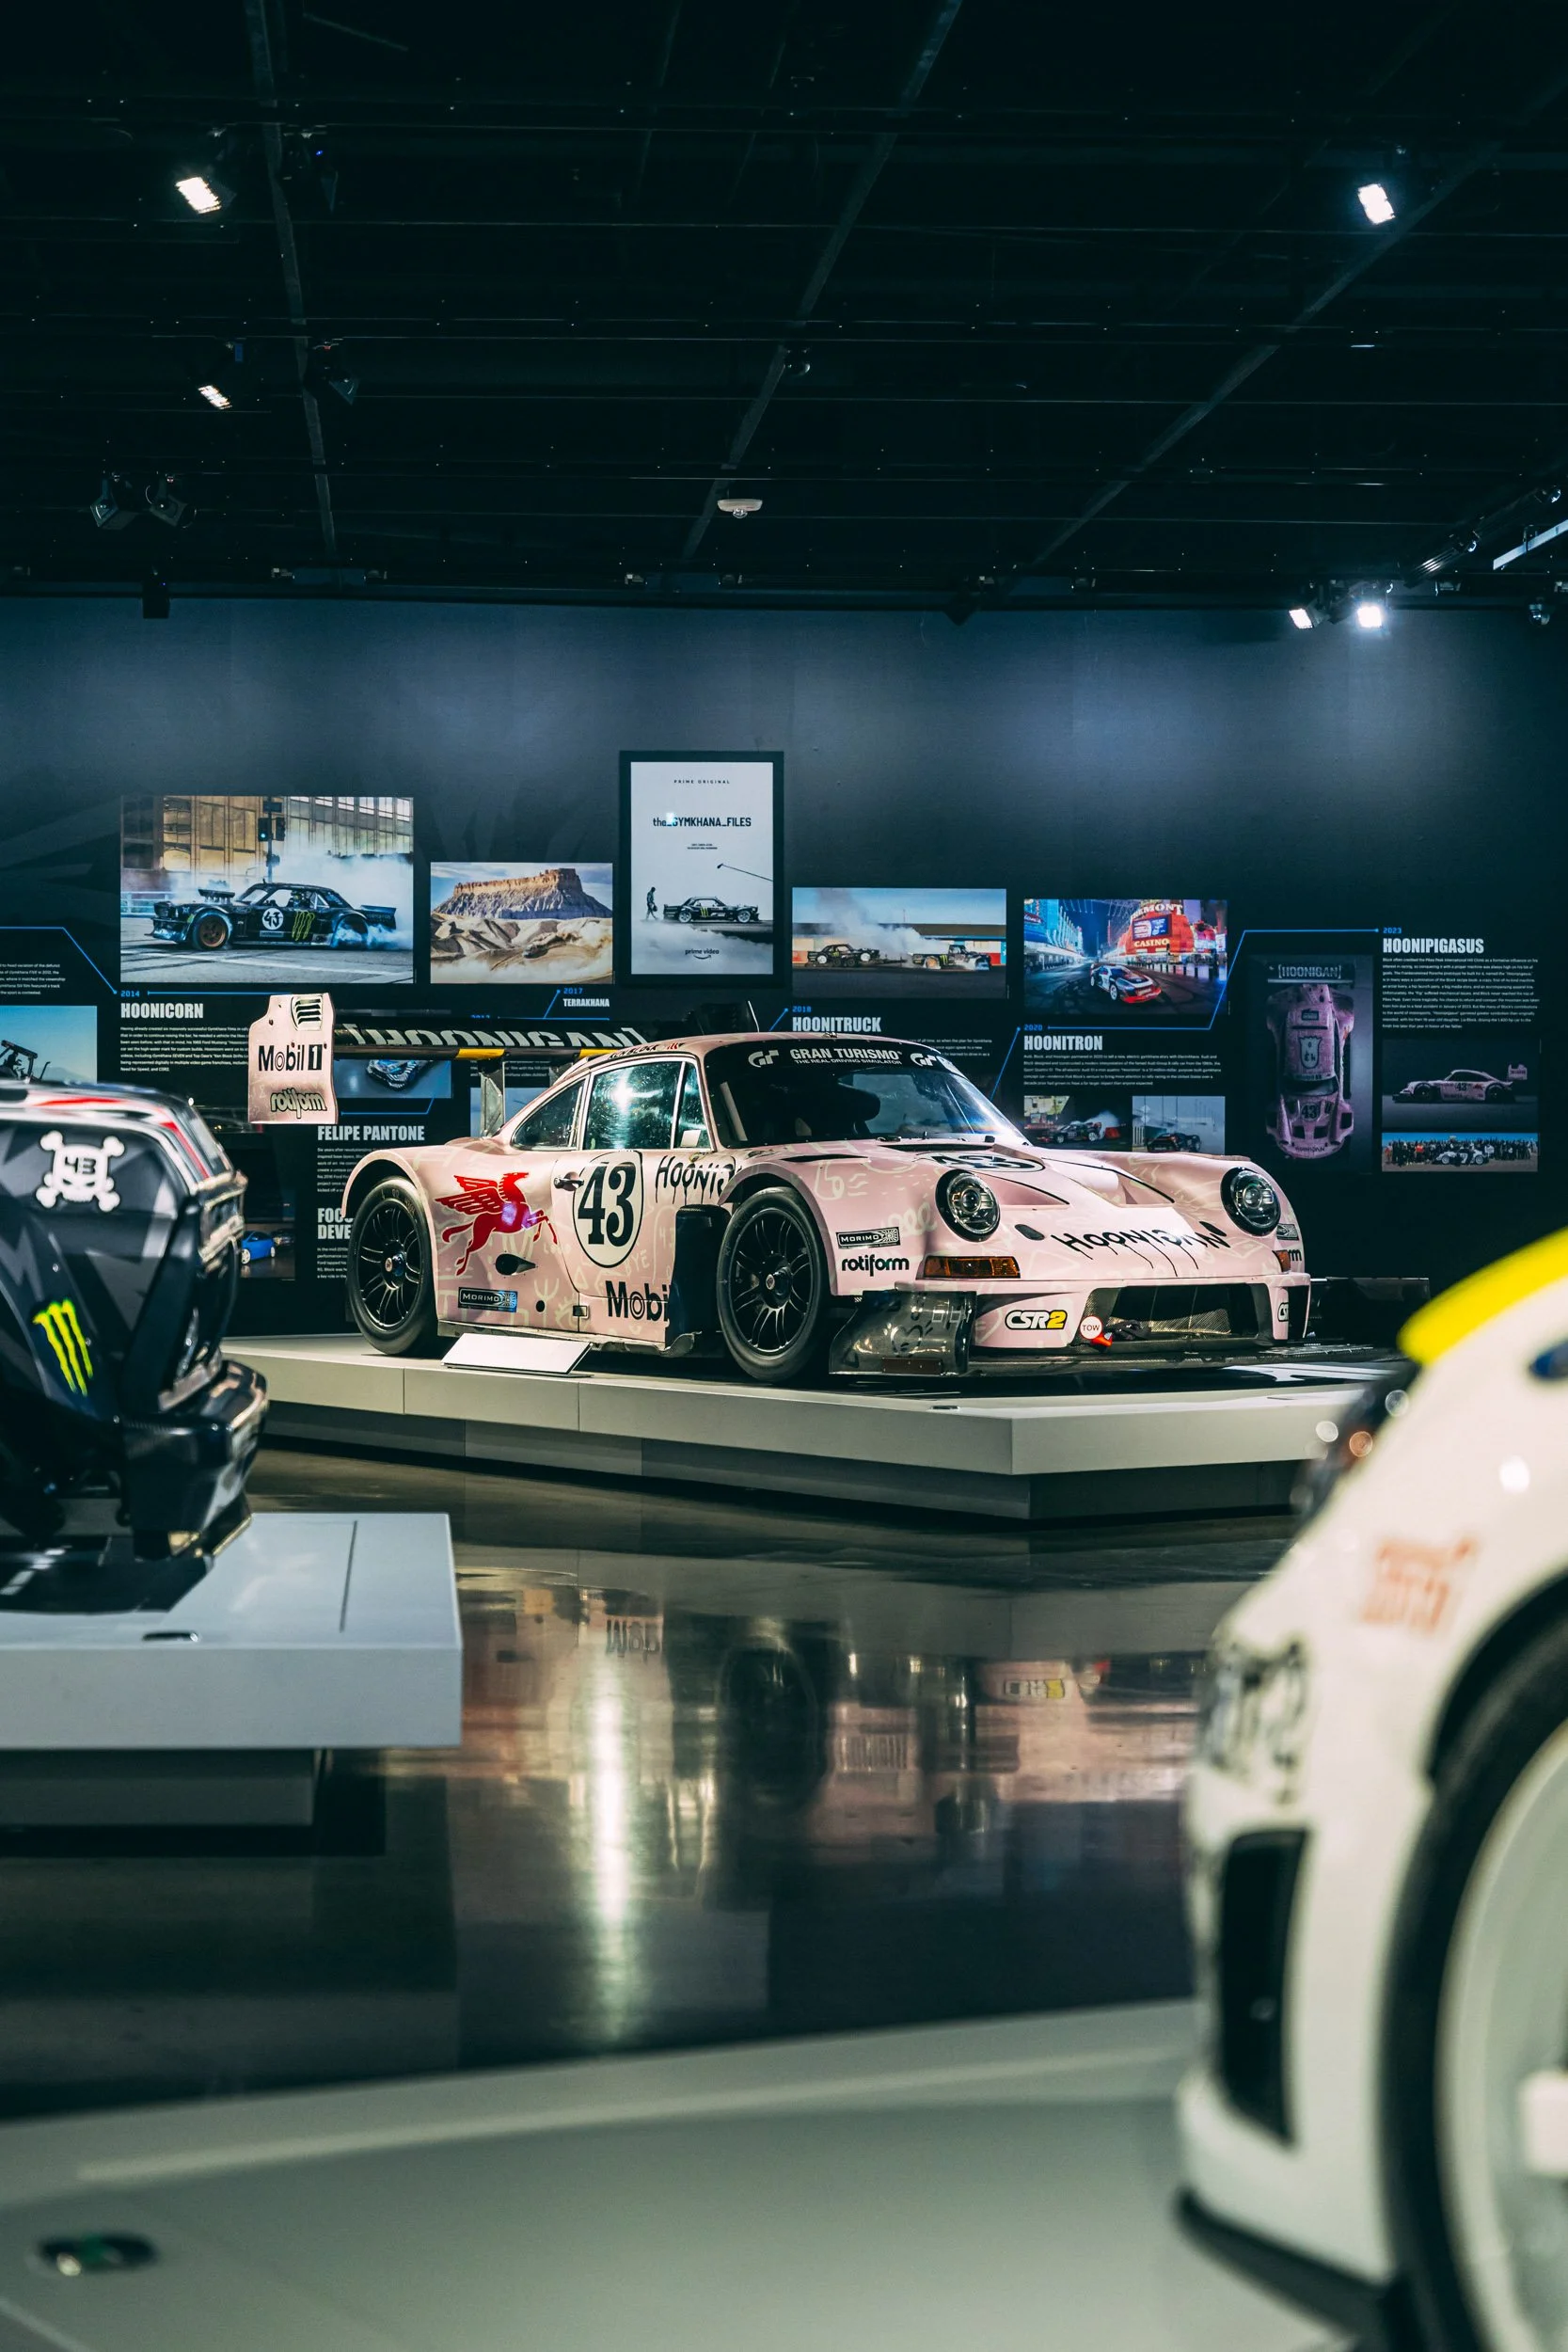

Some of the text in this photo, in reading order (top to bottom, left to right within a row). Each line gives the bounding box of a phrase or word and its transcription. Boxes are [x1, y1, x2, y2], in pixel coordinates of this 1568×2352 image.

[1133, 938, 1170, 947] CASINO
[1383, 937, 1484, 954] HOONIPIGASUS
[120, 1003, 203, 1018] HOONICORN
[562, 998, 610, 1007] TERRAKHANA
[792, 1016, 881, 1032] HOONITRUCK
[1023, 1035, 1102, 1051] HOONITRON
[258, 1044, 305, 1071] Mobil
[790, 1048, 900, 1060] GRAN TURISMO
[271, 1088, 327, 1120] rotiform
[317, 1125, 425, 1141] FELIPE PANTONE
[578, 1161, 636, 1248] 43
[317, 1208, 354, 1223] FOC
[317, 1224, 353, 1240] DEVE
[841, 1254, 910, 1277] rotiform
[606, 1279, 671, 1322] Mobi
[1005, 1310, 1068, 1330] CSR2
[1082, 1323, 1101, 1331] TOW
